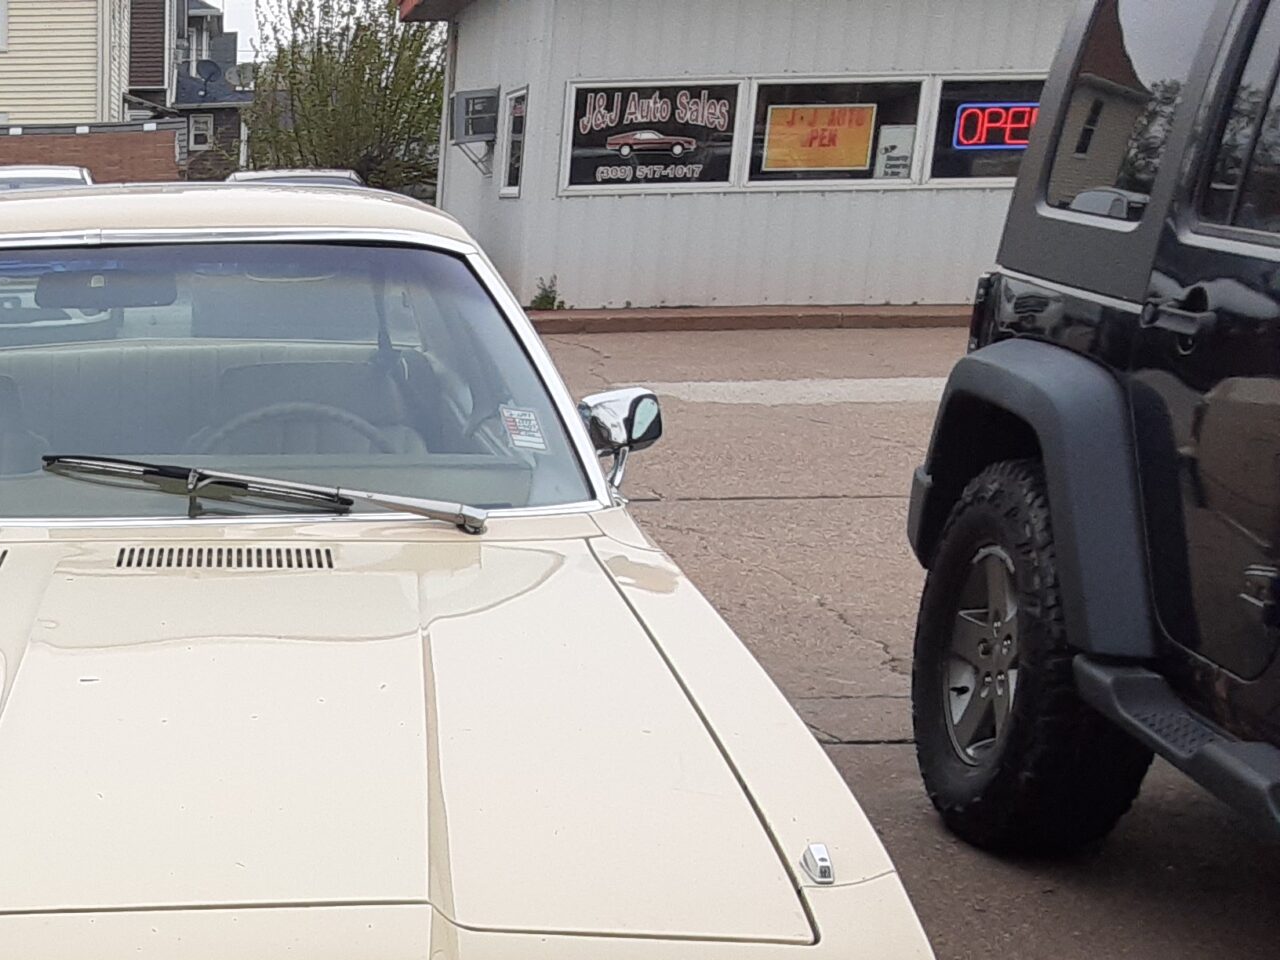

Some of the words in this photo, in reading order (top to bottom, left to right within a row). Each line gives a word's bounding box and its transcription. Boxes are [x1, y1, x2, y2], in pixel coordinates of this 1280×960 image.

[579, 92, 621, 134] J&J
[623, 90, 671, 124] Auto
[675, 90, 729, 131] Sales
[595, 165, 633, 182] (309)
[635, 164, 703, 179] 517-1017
